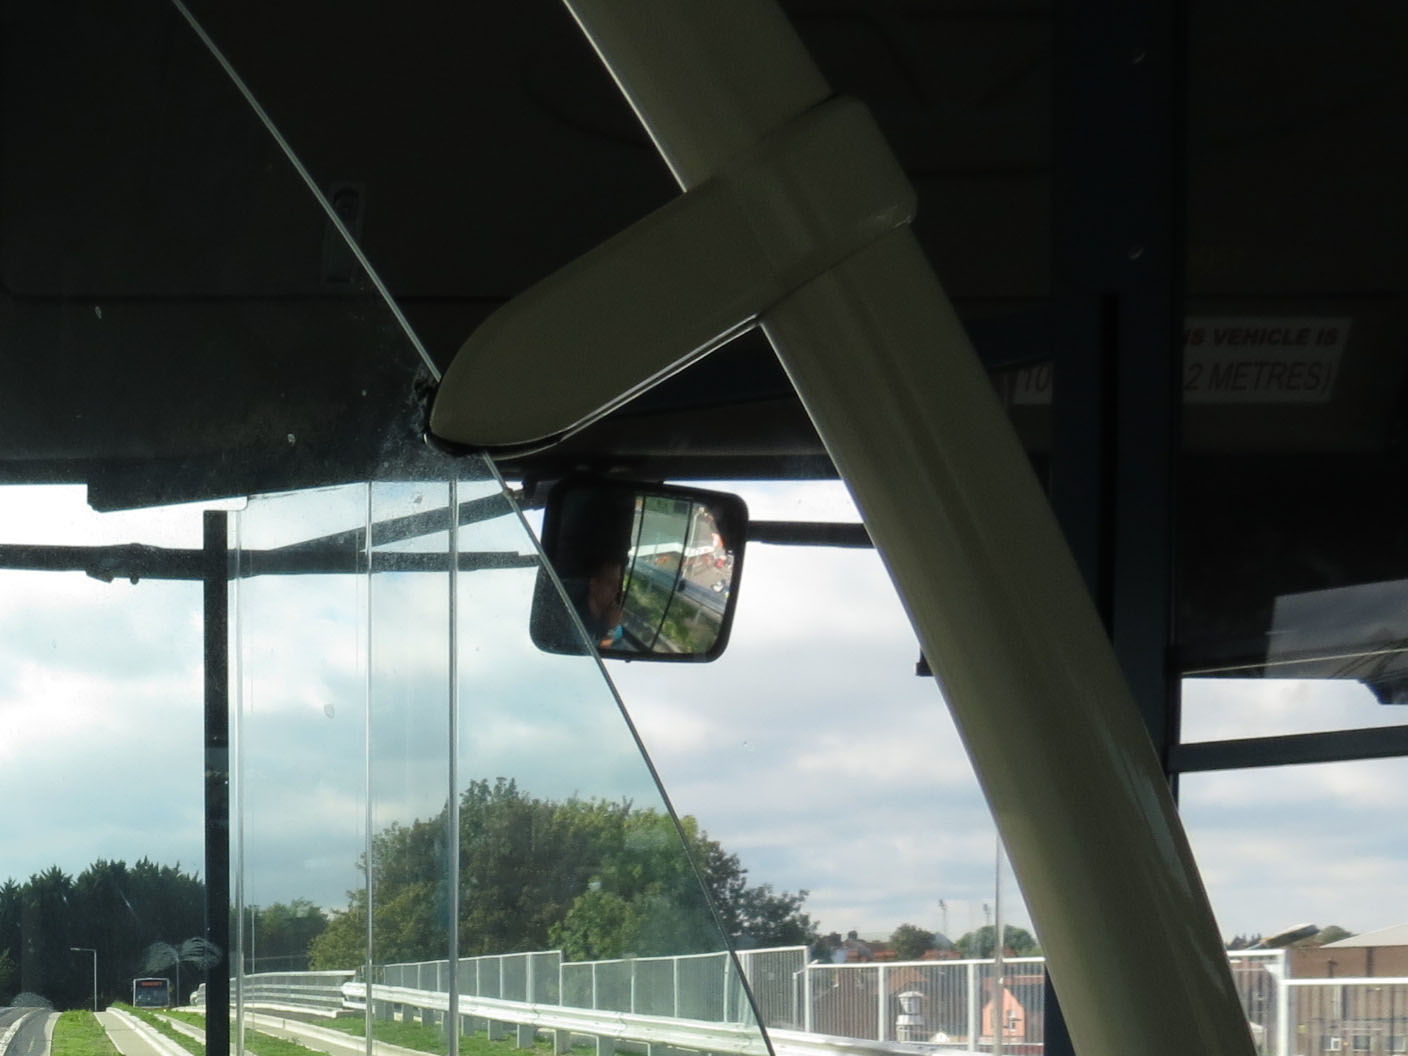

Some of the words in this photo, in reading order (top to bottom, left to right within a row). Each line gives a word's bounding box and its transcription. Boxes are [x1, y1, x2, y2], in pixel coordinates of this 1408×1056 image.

[1213, 328, 1311, 346] VEHICLE
[1315, 327, 1339, 344] IS
[1208, 361, 1333, 394] METRES)
